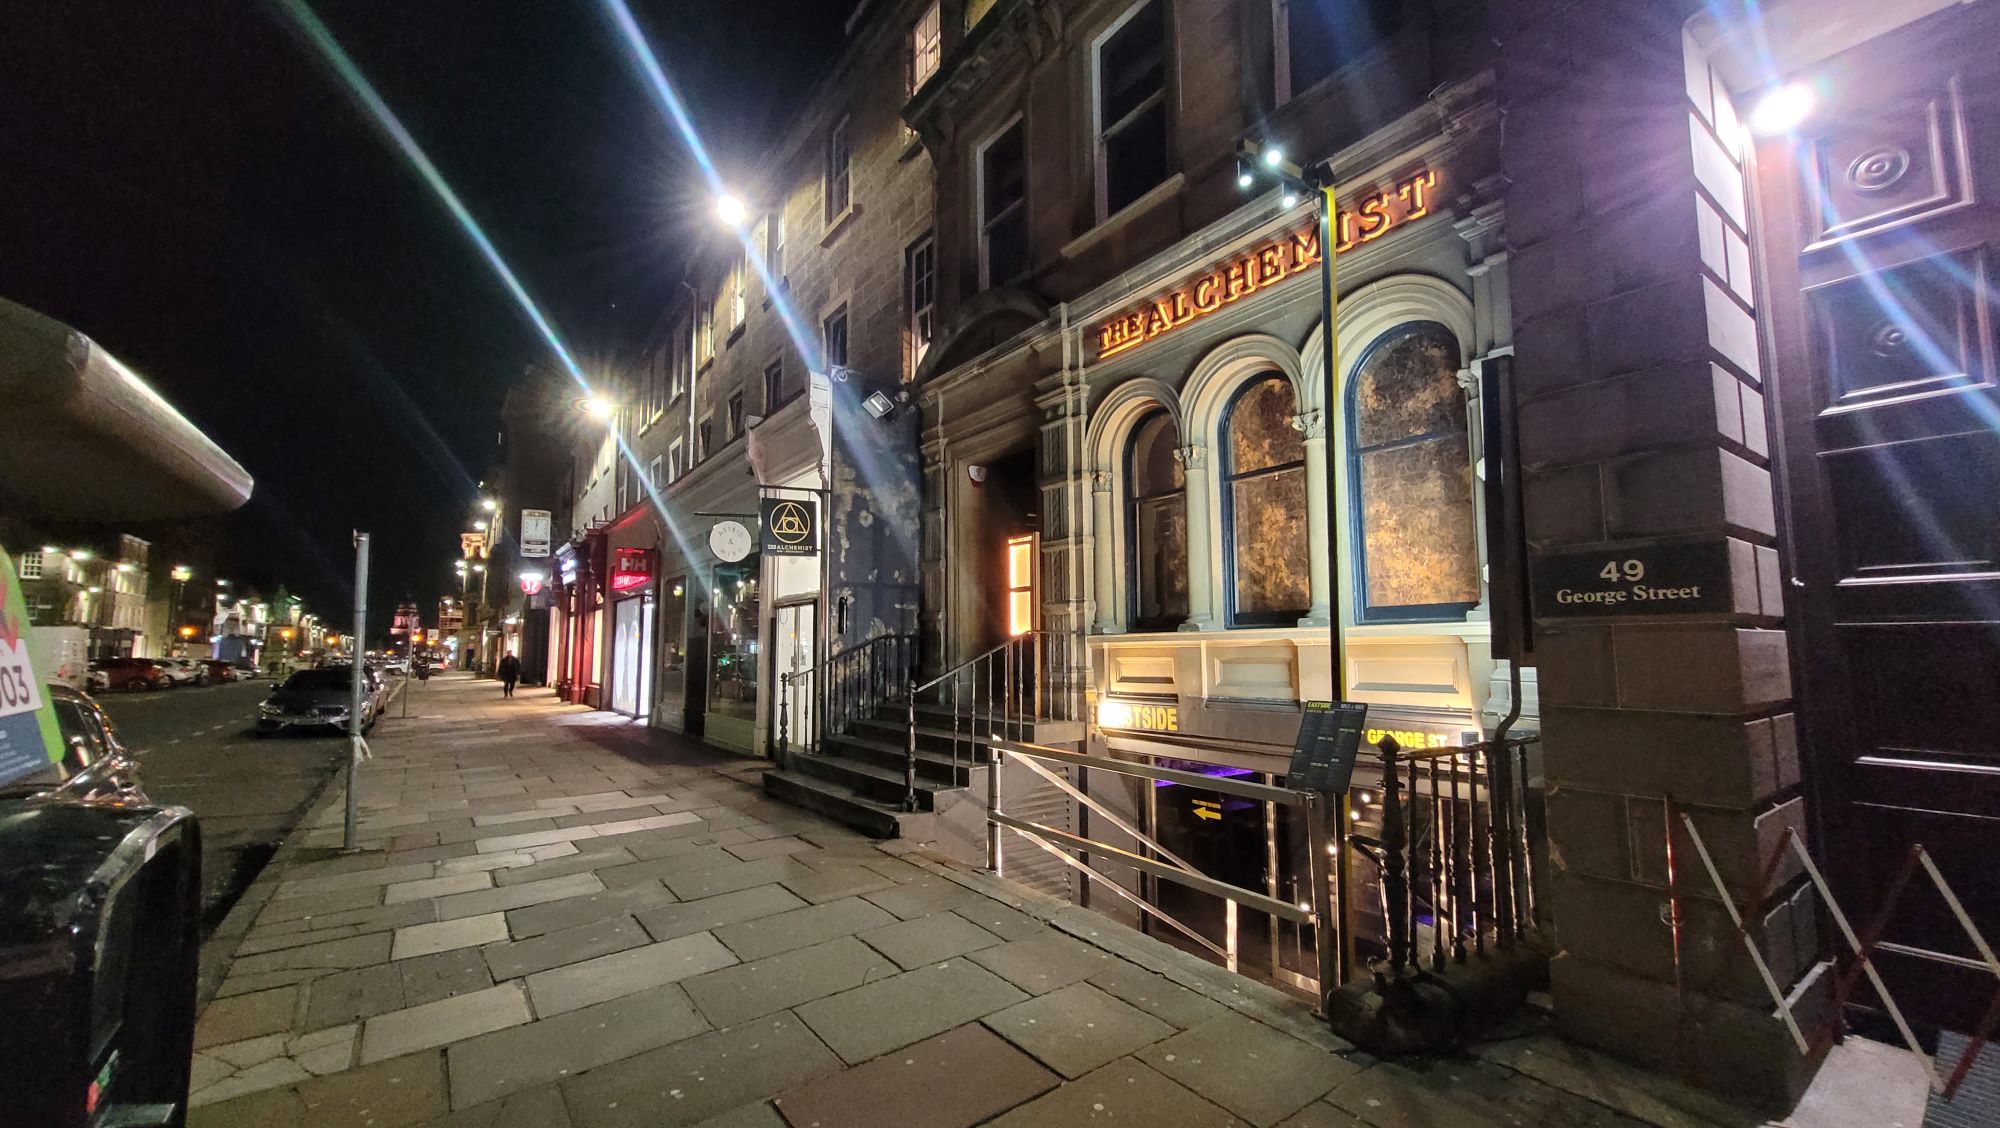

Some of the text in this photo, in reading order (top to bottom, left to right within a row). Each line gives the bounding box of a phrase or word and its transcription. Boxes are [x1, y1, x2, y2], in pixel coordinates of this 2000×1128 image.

[1098, 168, 1437, 351] THE ALCHEMIST
[1600, 559, 1645, 582] 49
[1556, 585, 1701, 605] George Street
[0, 665, 30, 709] 03
[1428, 734, 1448, 748] ST
